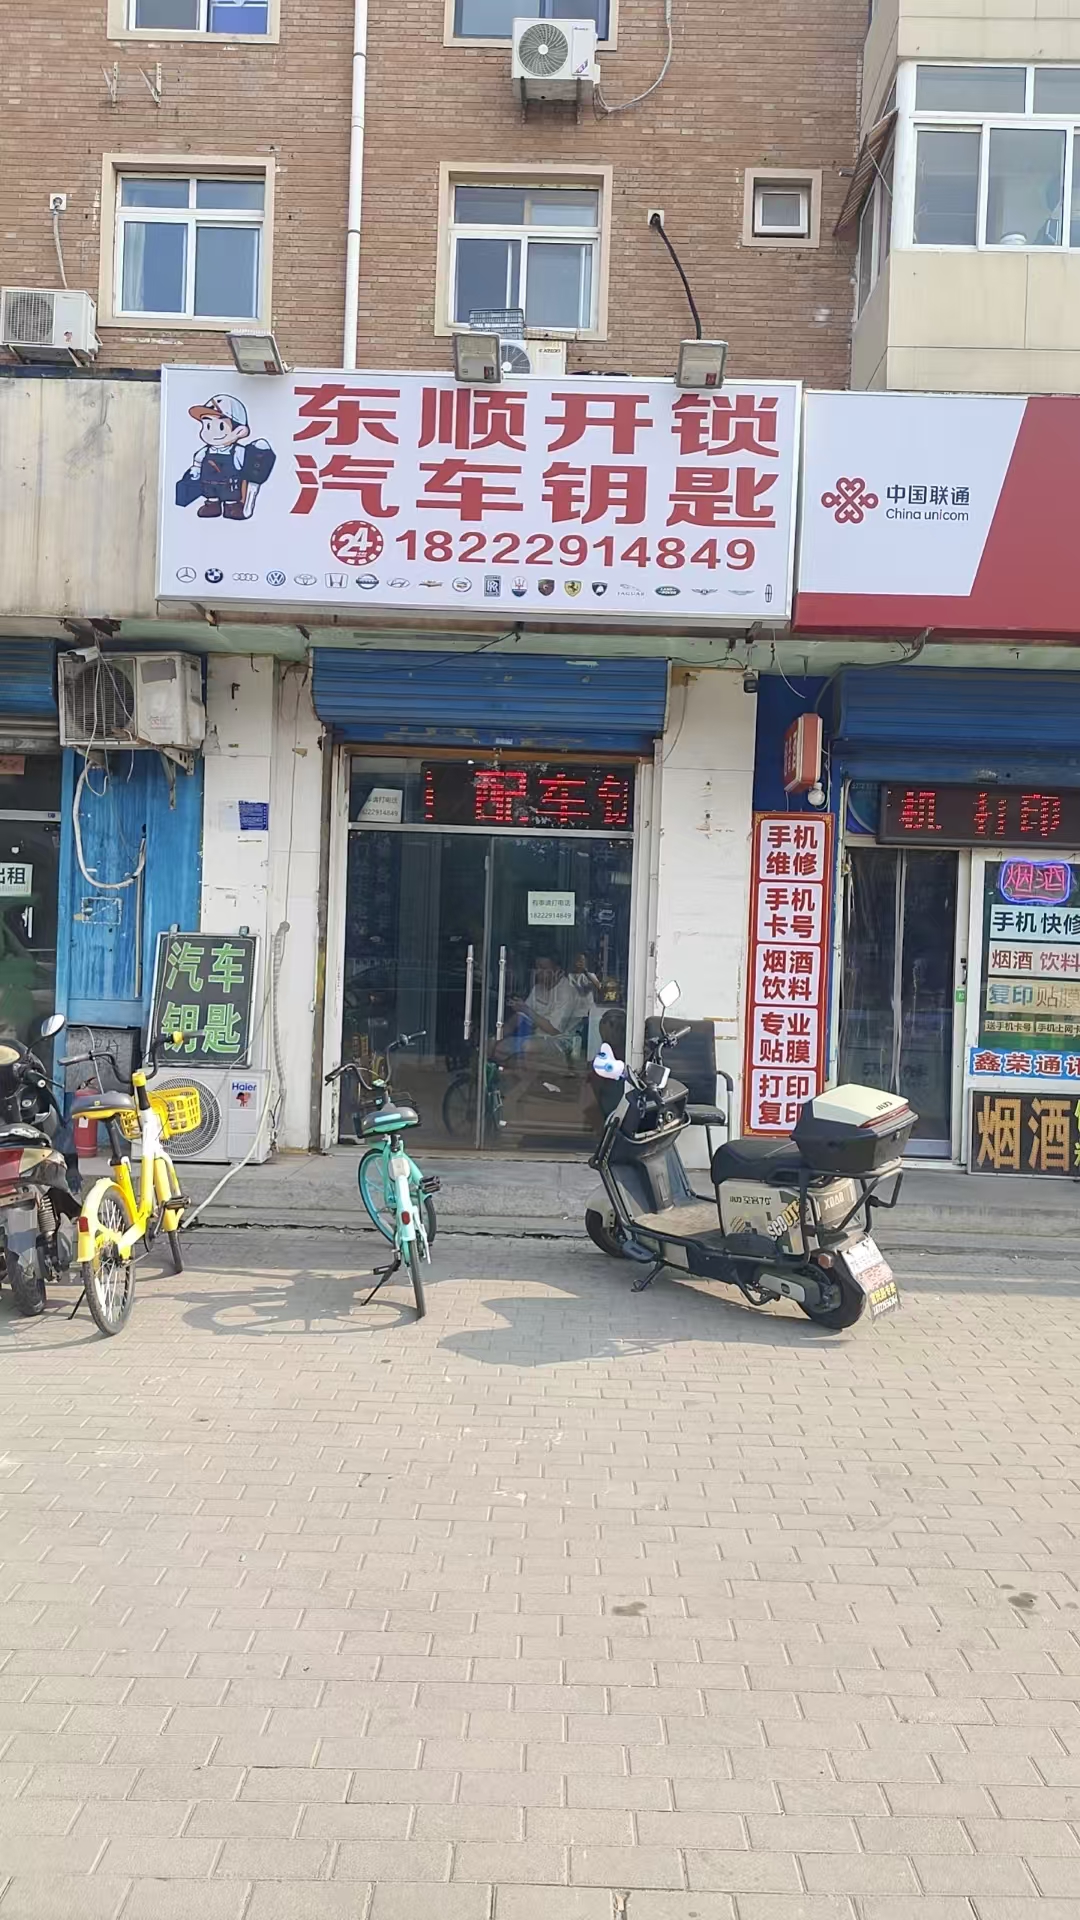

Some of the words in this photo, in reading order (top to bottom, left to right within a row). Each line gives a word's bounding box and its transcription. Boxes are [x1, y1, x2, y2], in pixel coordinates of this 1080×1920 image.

[293, 384, 780, 457] 东顺开锁
[290, 455, 779, 528] 汽车钥匙
[886, 484, 970, 506] 中国联通
[886, 508, 921, 520] China
[924, 509, 969, 521] unicom
[337, 527, 373, 557] 24
[396, 529, 756, 570] 18222914849
[767, 825, 818, 850] 手机
[0, 867, 25, 884] 租
[766, 851, 817, 876] 维修
[1003, 863, 1064, 893] 烟酒
[765, 888, 815, 912] 手机
[764, 914, 815, 938] 卡号
[992, 911, 1080, 936] 手机快修
[166, 941, 246, 993] 汽车
[763, 949, 813, 975] 烟酒
[762, 976, 812, 1001] 饮料
[161, 1001, 242, 1054] 钥匙
[761, 1011, 811, 1036] 专业
[760, 1039, 811, 1064] 贴膜
[232, 1082, 257, 1091] Haier
[759, 1074, 809, 1099] 打印
[976, 1096, 1080, 1172] 烟酒
